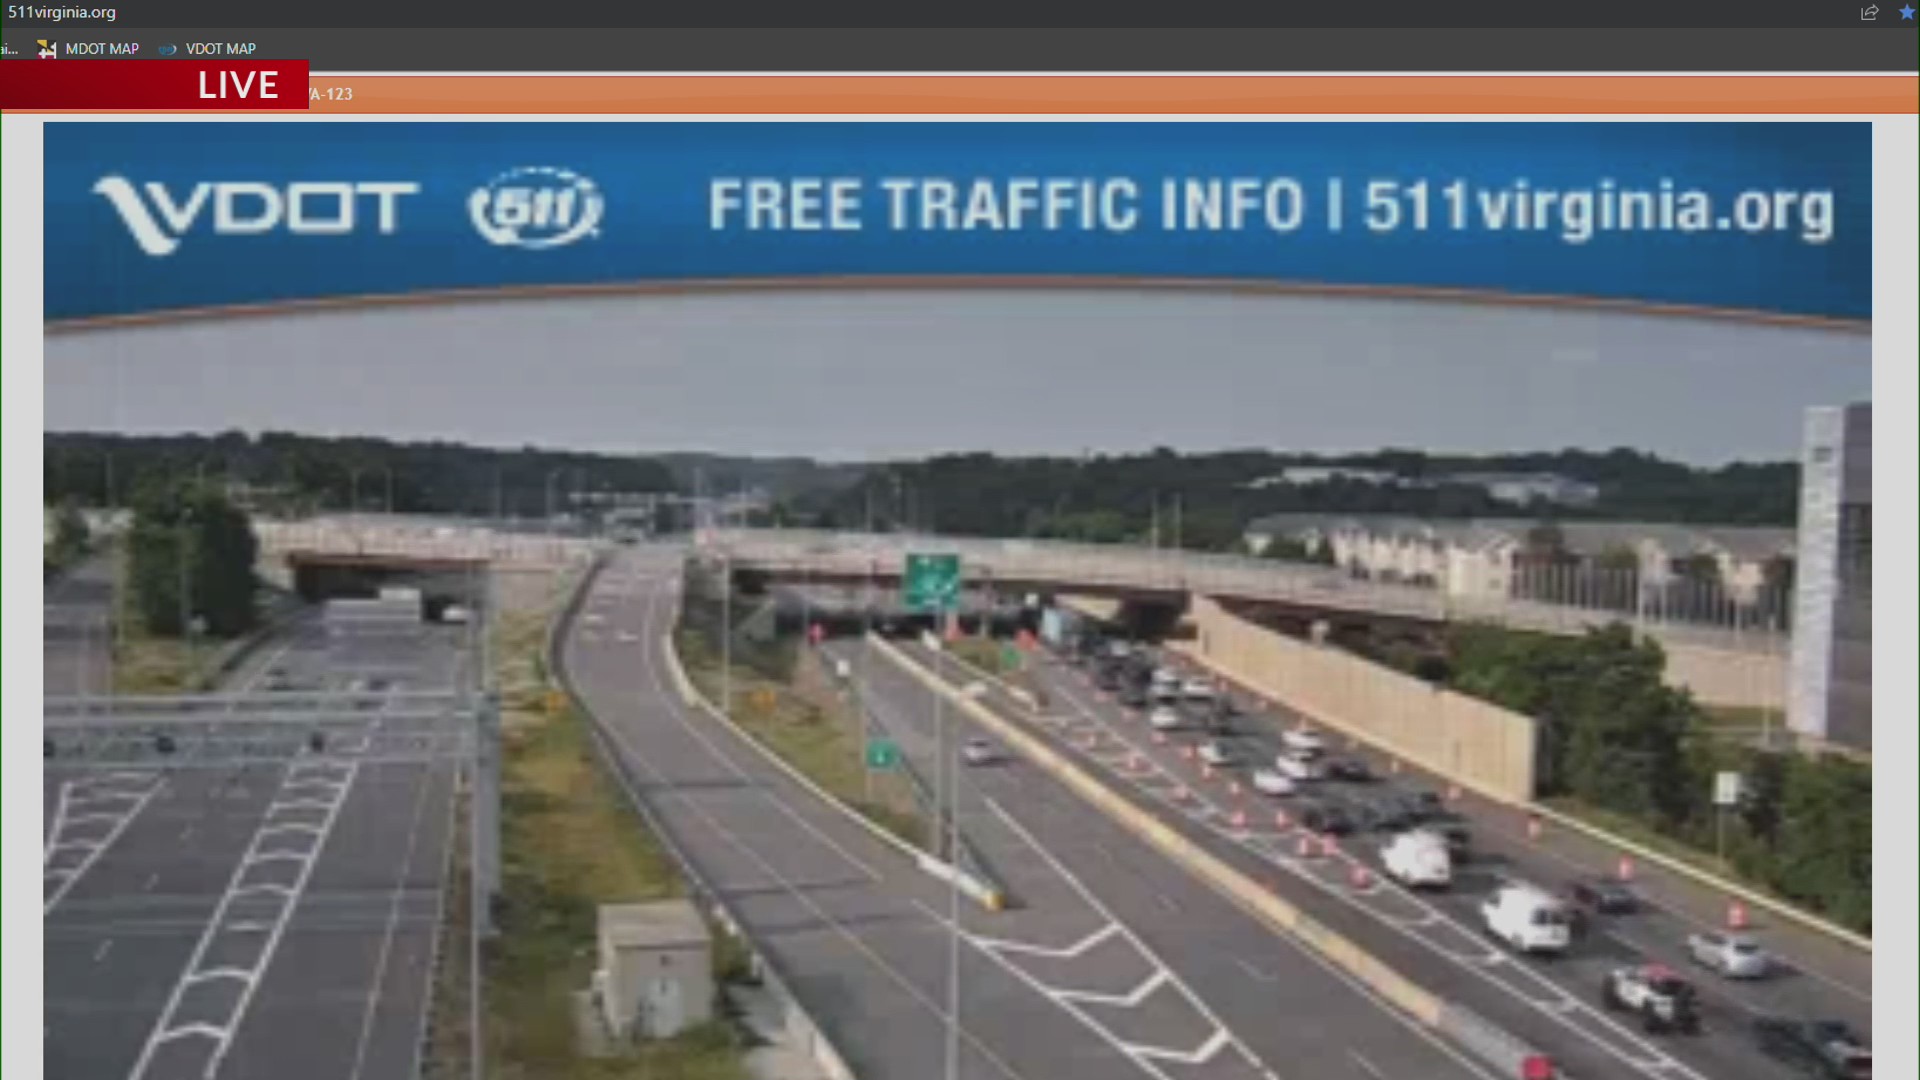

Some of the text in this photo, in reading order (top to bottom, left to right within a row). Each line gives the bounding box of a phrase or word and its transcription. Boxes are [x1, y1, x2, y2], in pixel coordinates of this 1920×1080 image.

[8, 5, 116, 22] 511virginia.org
[66, 42, 139, 55] MDOT MAP
[186, 42, 257, 55] VDOT MAP
[93, 175, 421, 256] VDOT
[709, 176, 863, 232] FREE
[881, 176, 1138, 232] TRAFFIC
[1161, 176, 1303, 232] INFO
[1364, 178, 1835, 243] 511virginia.org
